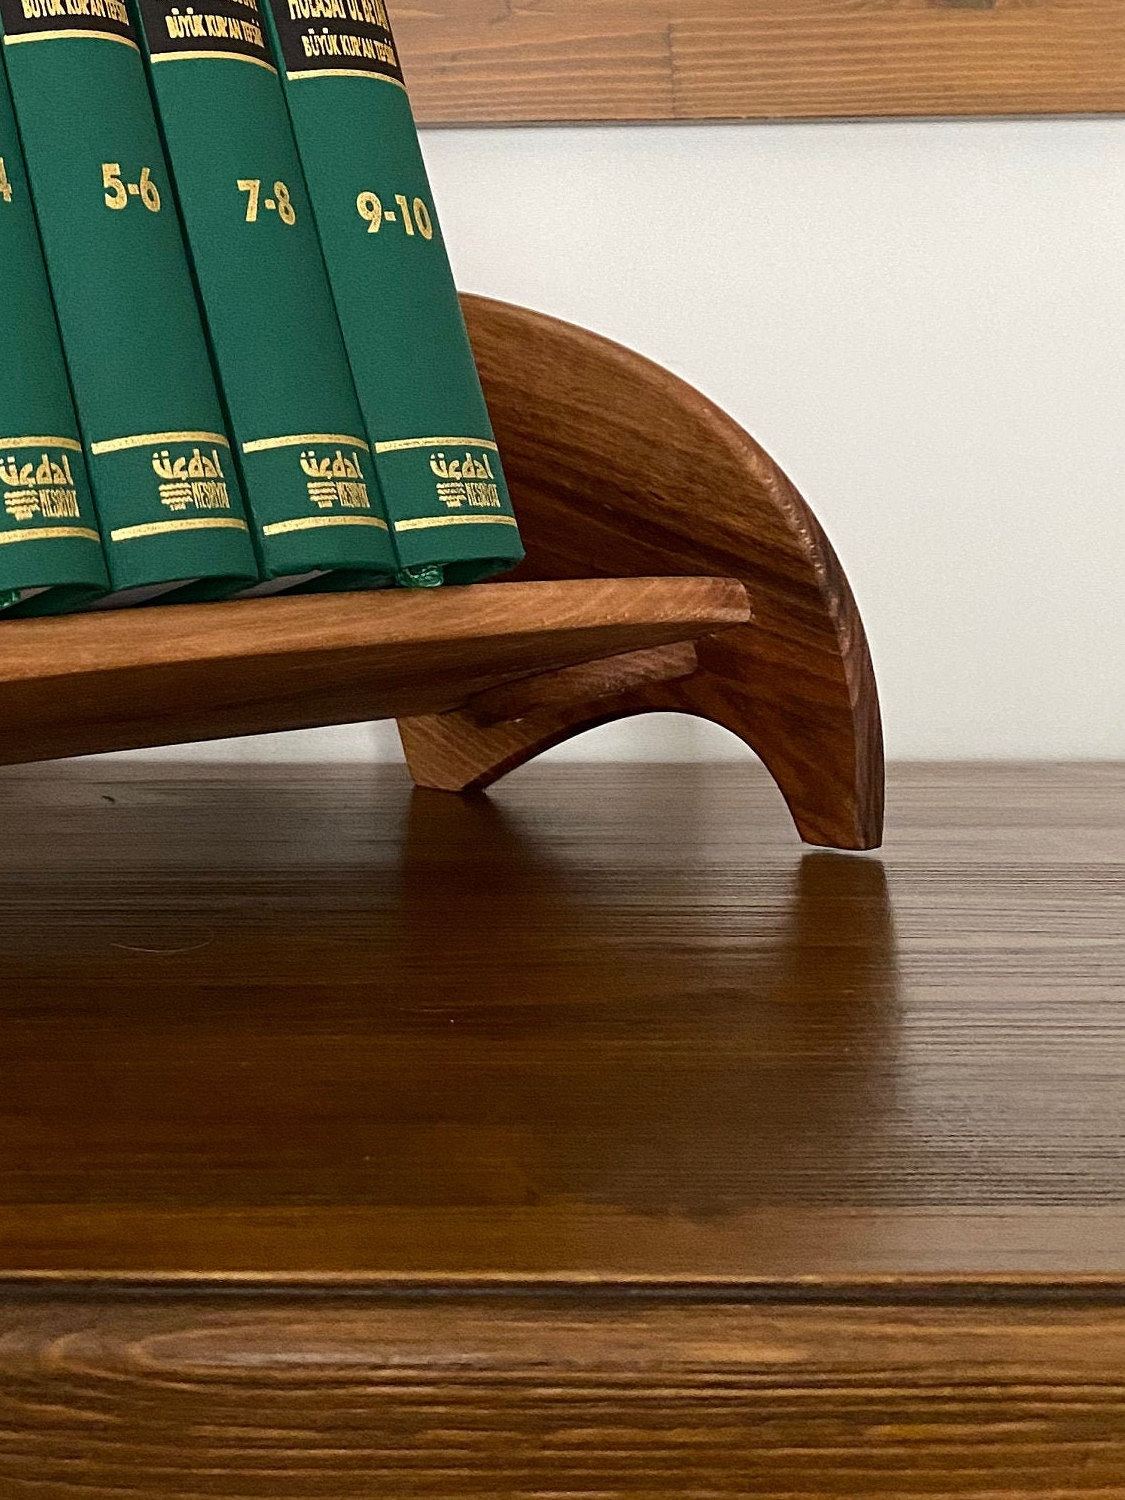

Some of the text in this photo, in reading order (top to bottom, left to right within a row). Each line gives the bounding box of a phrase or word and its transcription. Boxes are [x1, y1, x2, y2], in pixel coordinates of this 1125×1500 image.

[165, 6, 208, 39] BÜYÜK
[204, 14, 243, 40] KUR'AN
[301, 27, 342, 57] BÜYÜK
[339, 34, 377, 59] KUR'AN
[101, 162, 161, 213] 5-6
[237, 178, 296, 226] 7-8
[356, 191, 433, 240] 9-10
[152, 448, 224, 481] üçdal
[300, 450, 364, 480] üçdal
[429, 452, 494, 480] üçdal
